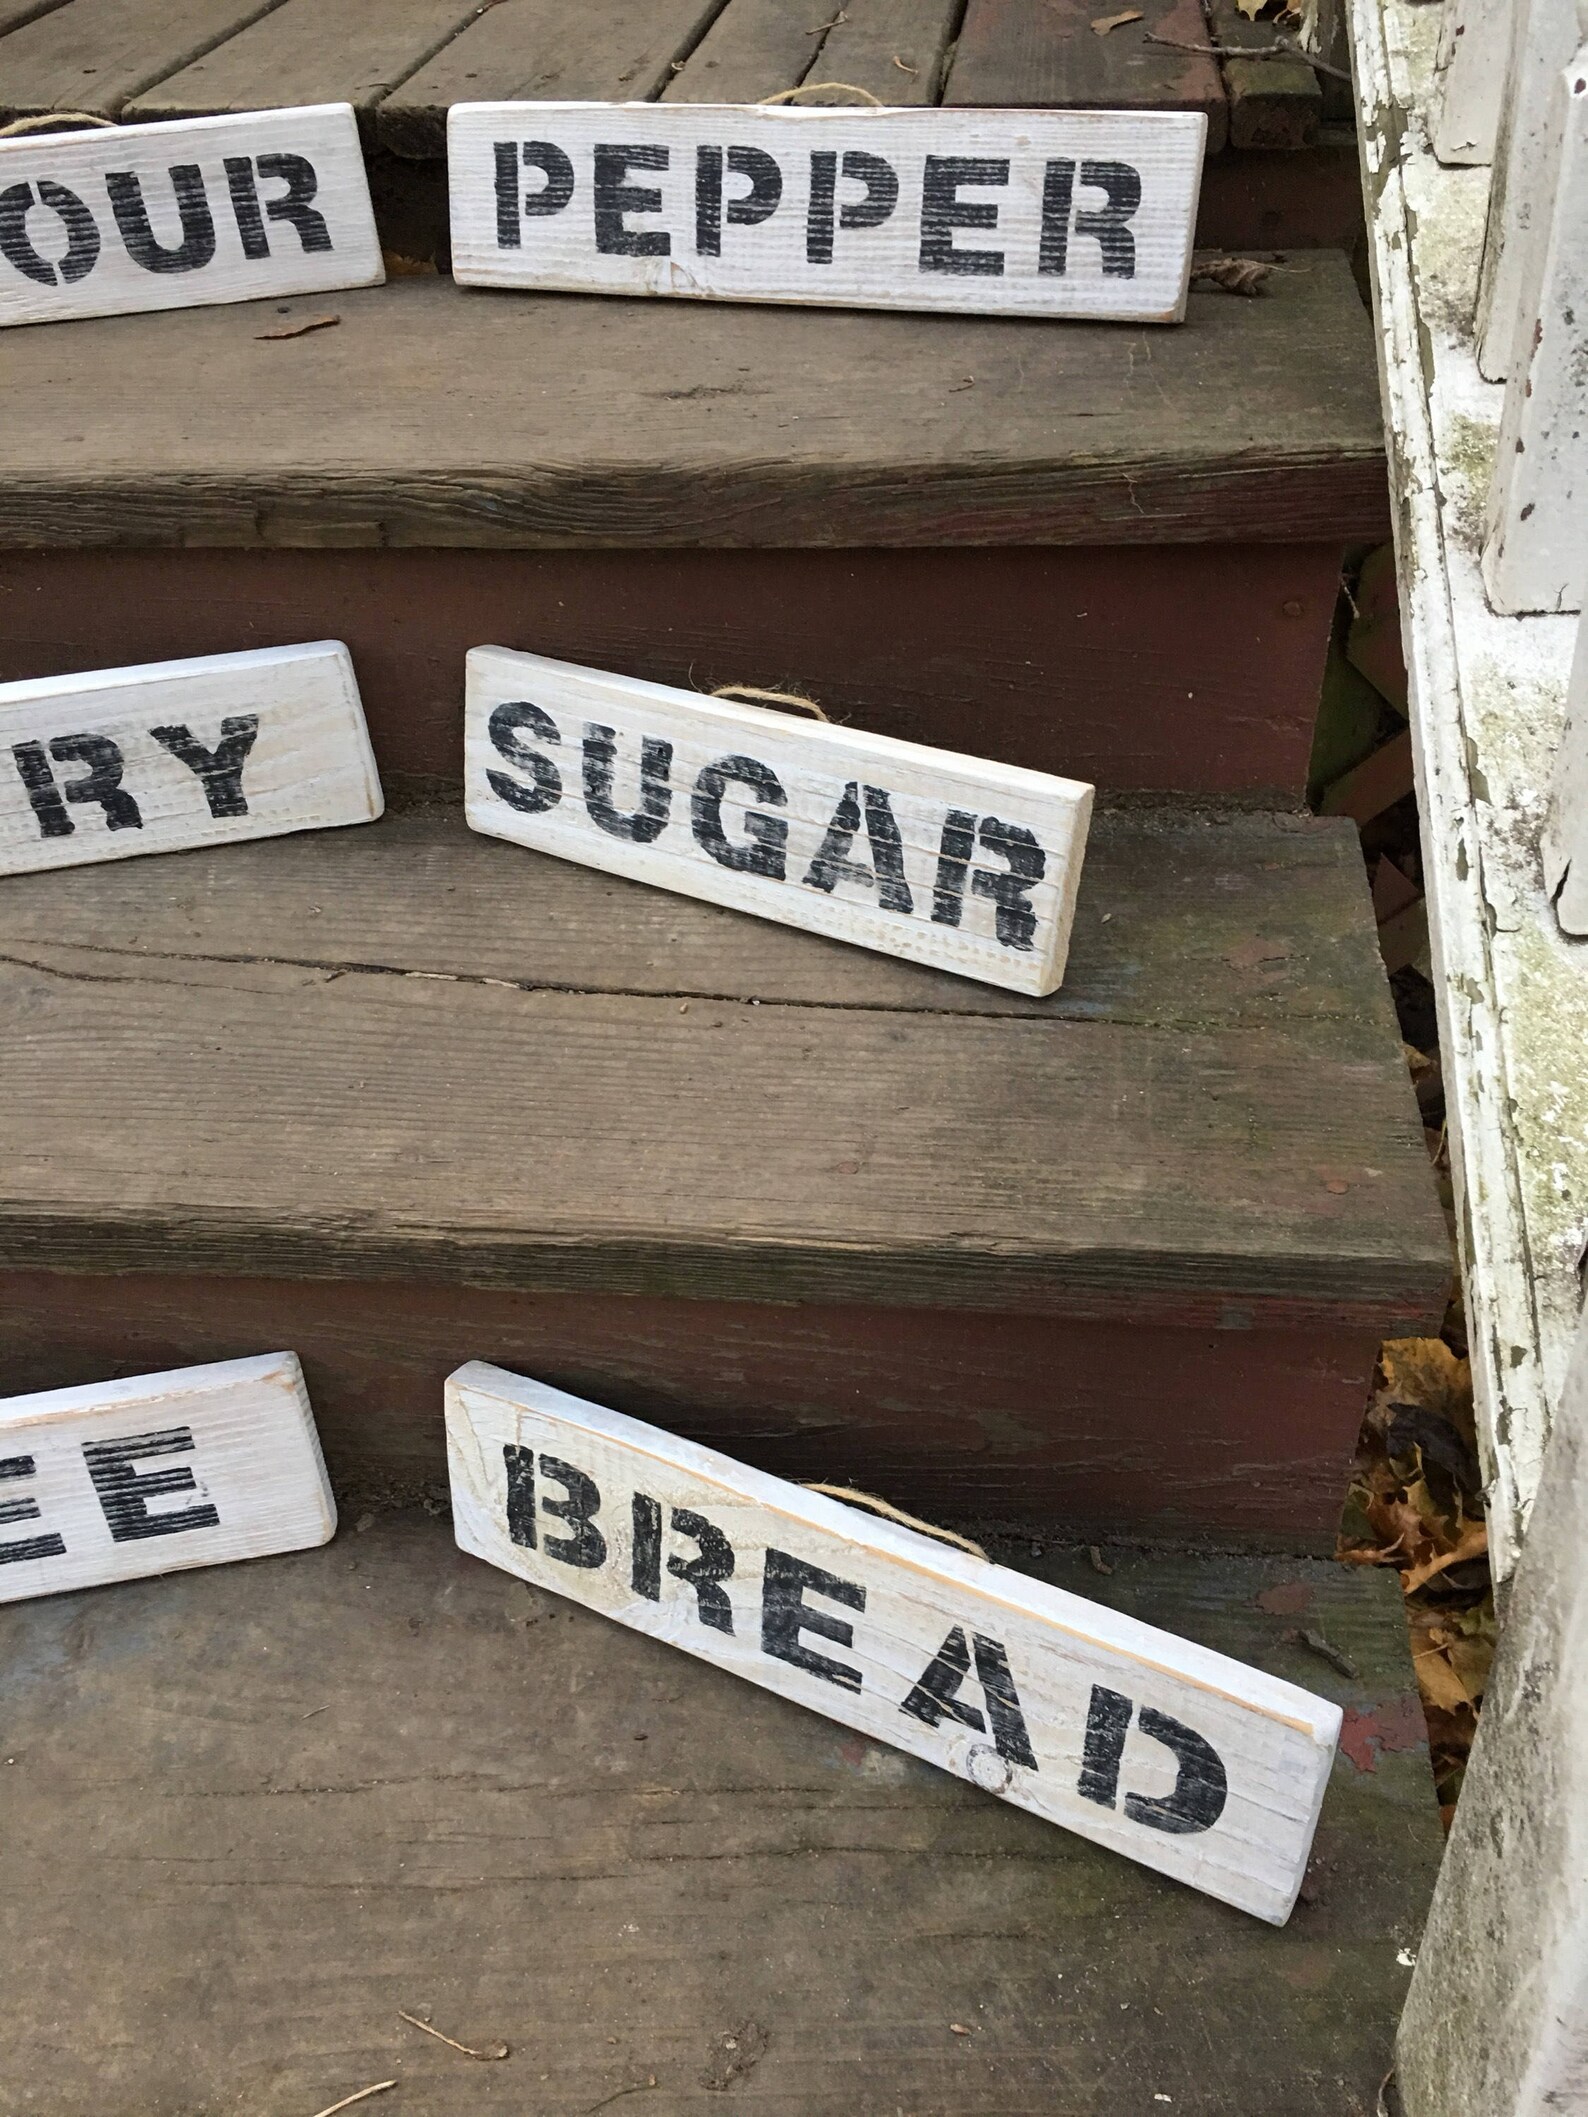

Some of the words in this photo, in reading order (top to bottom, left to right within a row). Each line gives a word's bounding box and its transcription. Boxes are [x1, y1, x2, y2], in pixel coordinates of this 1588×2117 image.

[0, 153, 334, 286] OUR
[493, 140, 1142, 280] PEPPER
[11, 713, 259, 839] RY
[486, 701, 1047, 952] SUGAR
[502, 1444, 1228, 1835] BREAD
